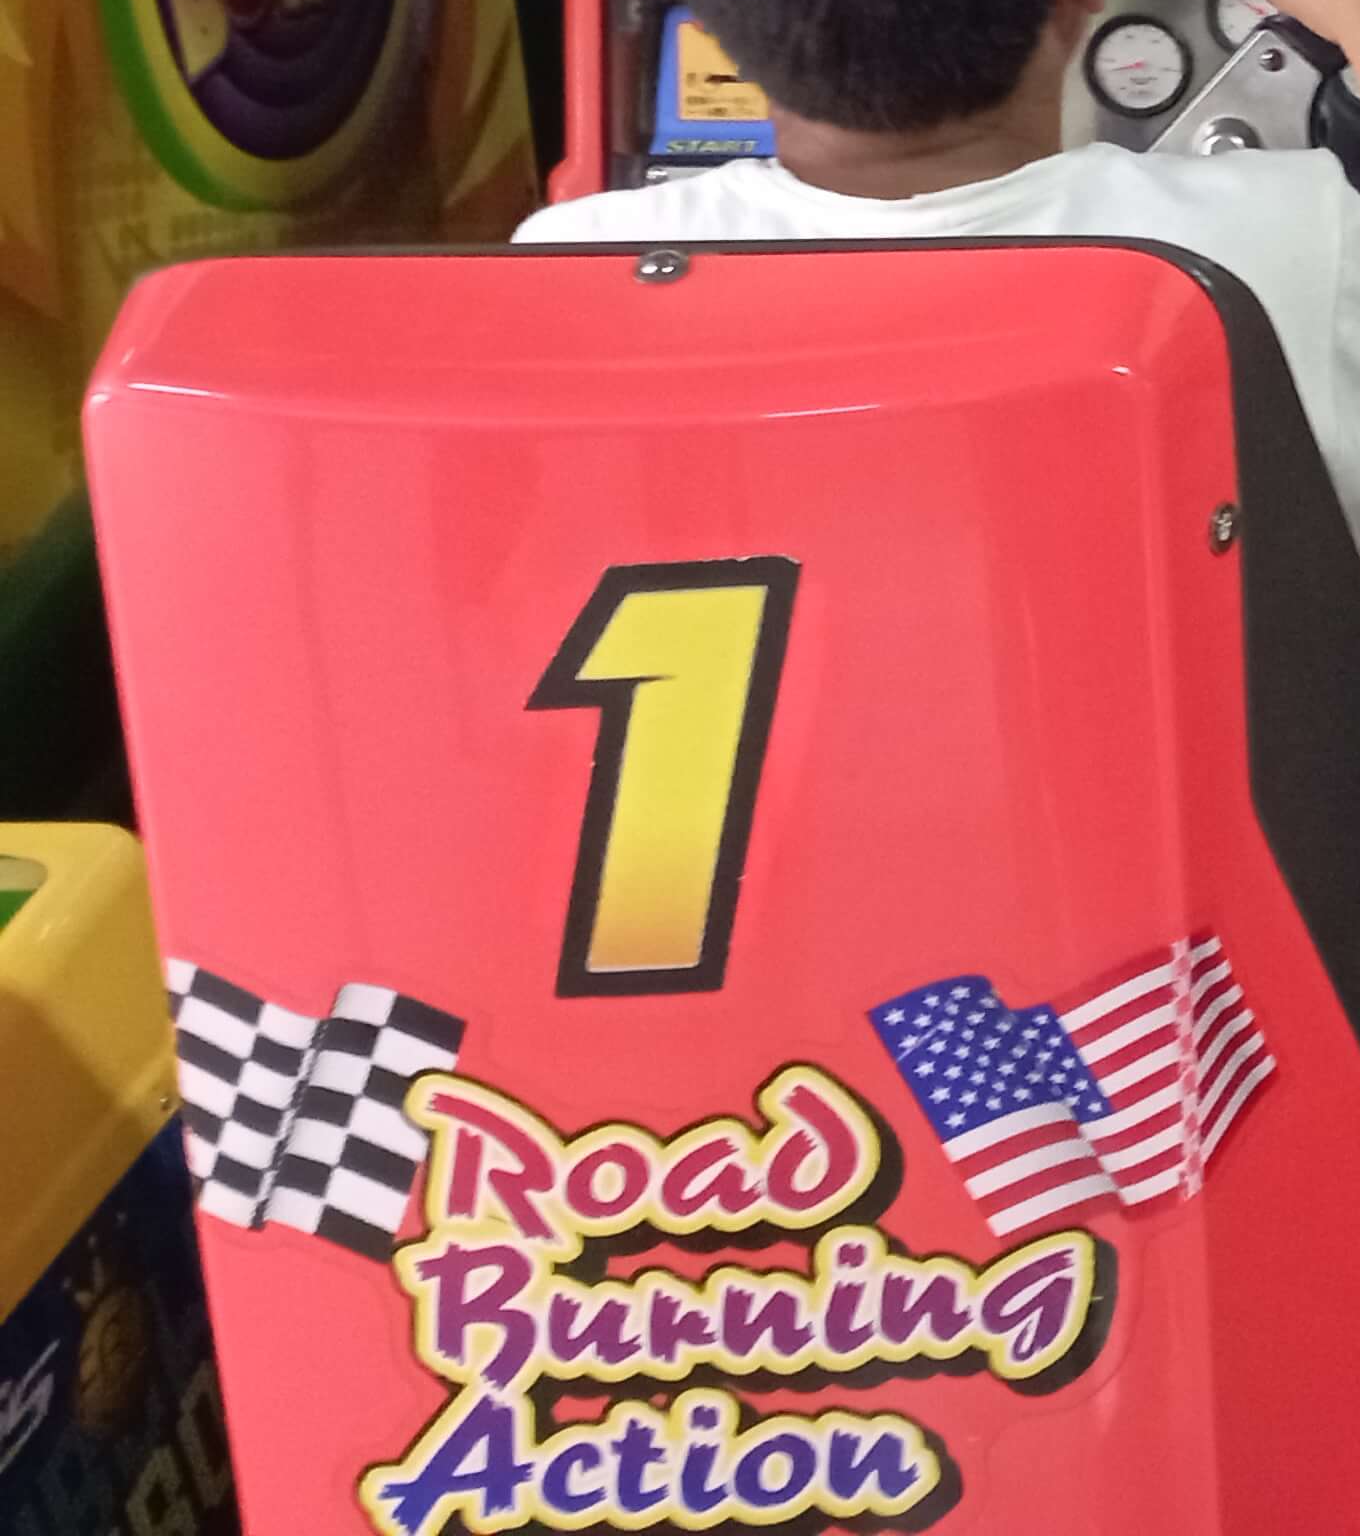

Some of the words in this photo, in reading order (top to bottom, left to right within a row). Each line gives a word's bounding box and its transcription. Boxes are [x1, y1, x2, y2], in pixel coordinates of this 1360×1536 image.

[527, 556, 801, 997] 1
[427, 1084, 862, 1244] Road
[415, 1242, 1076, 1389] Burning
[378, 1389, 920, 1536] Action
